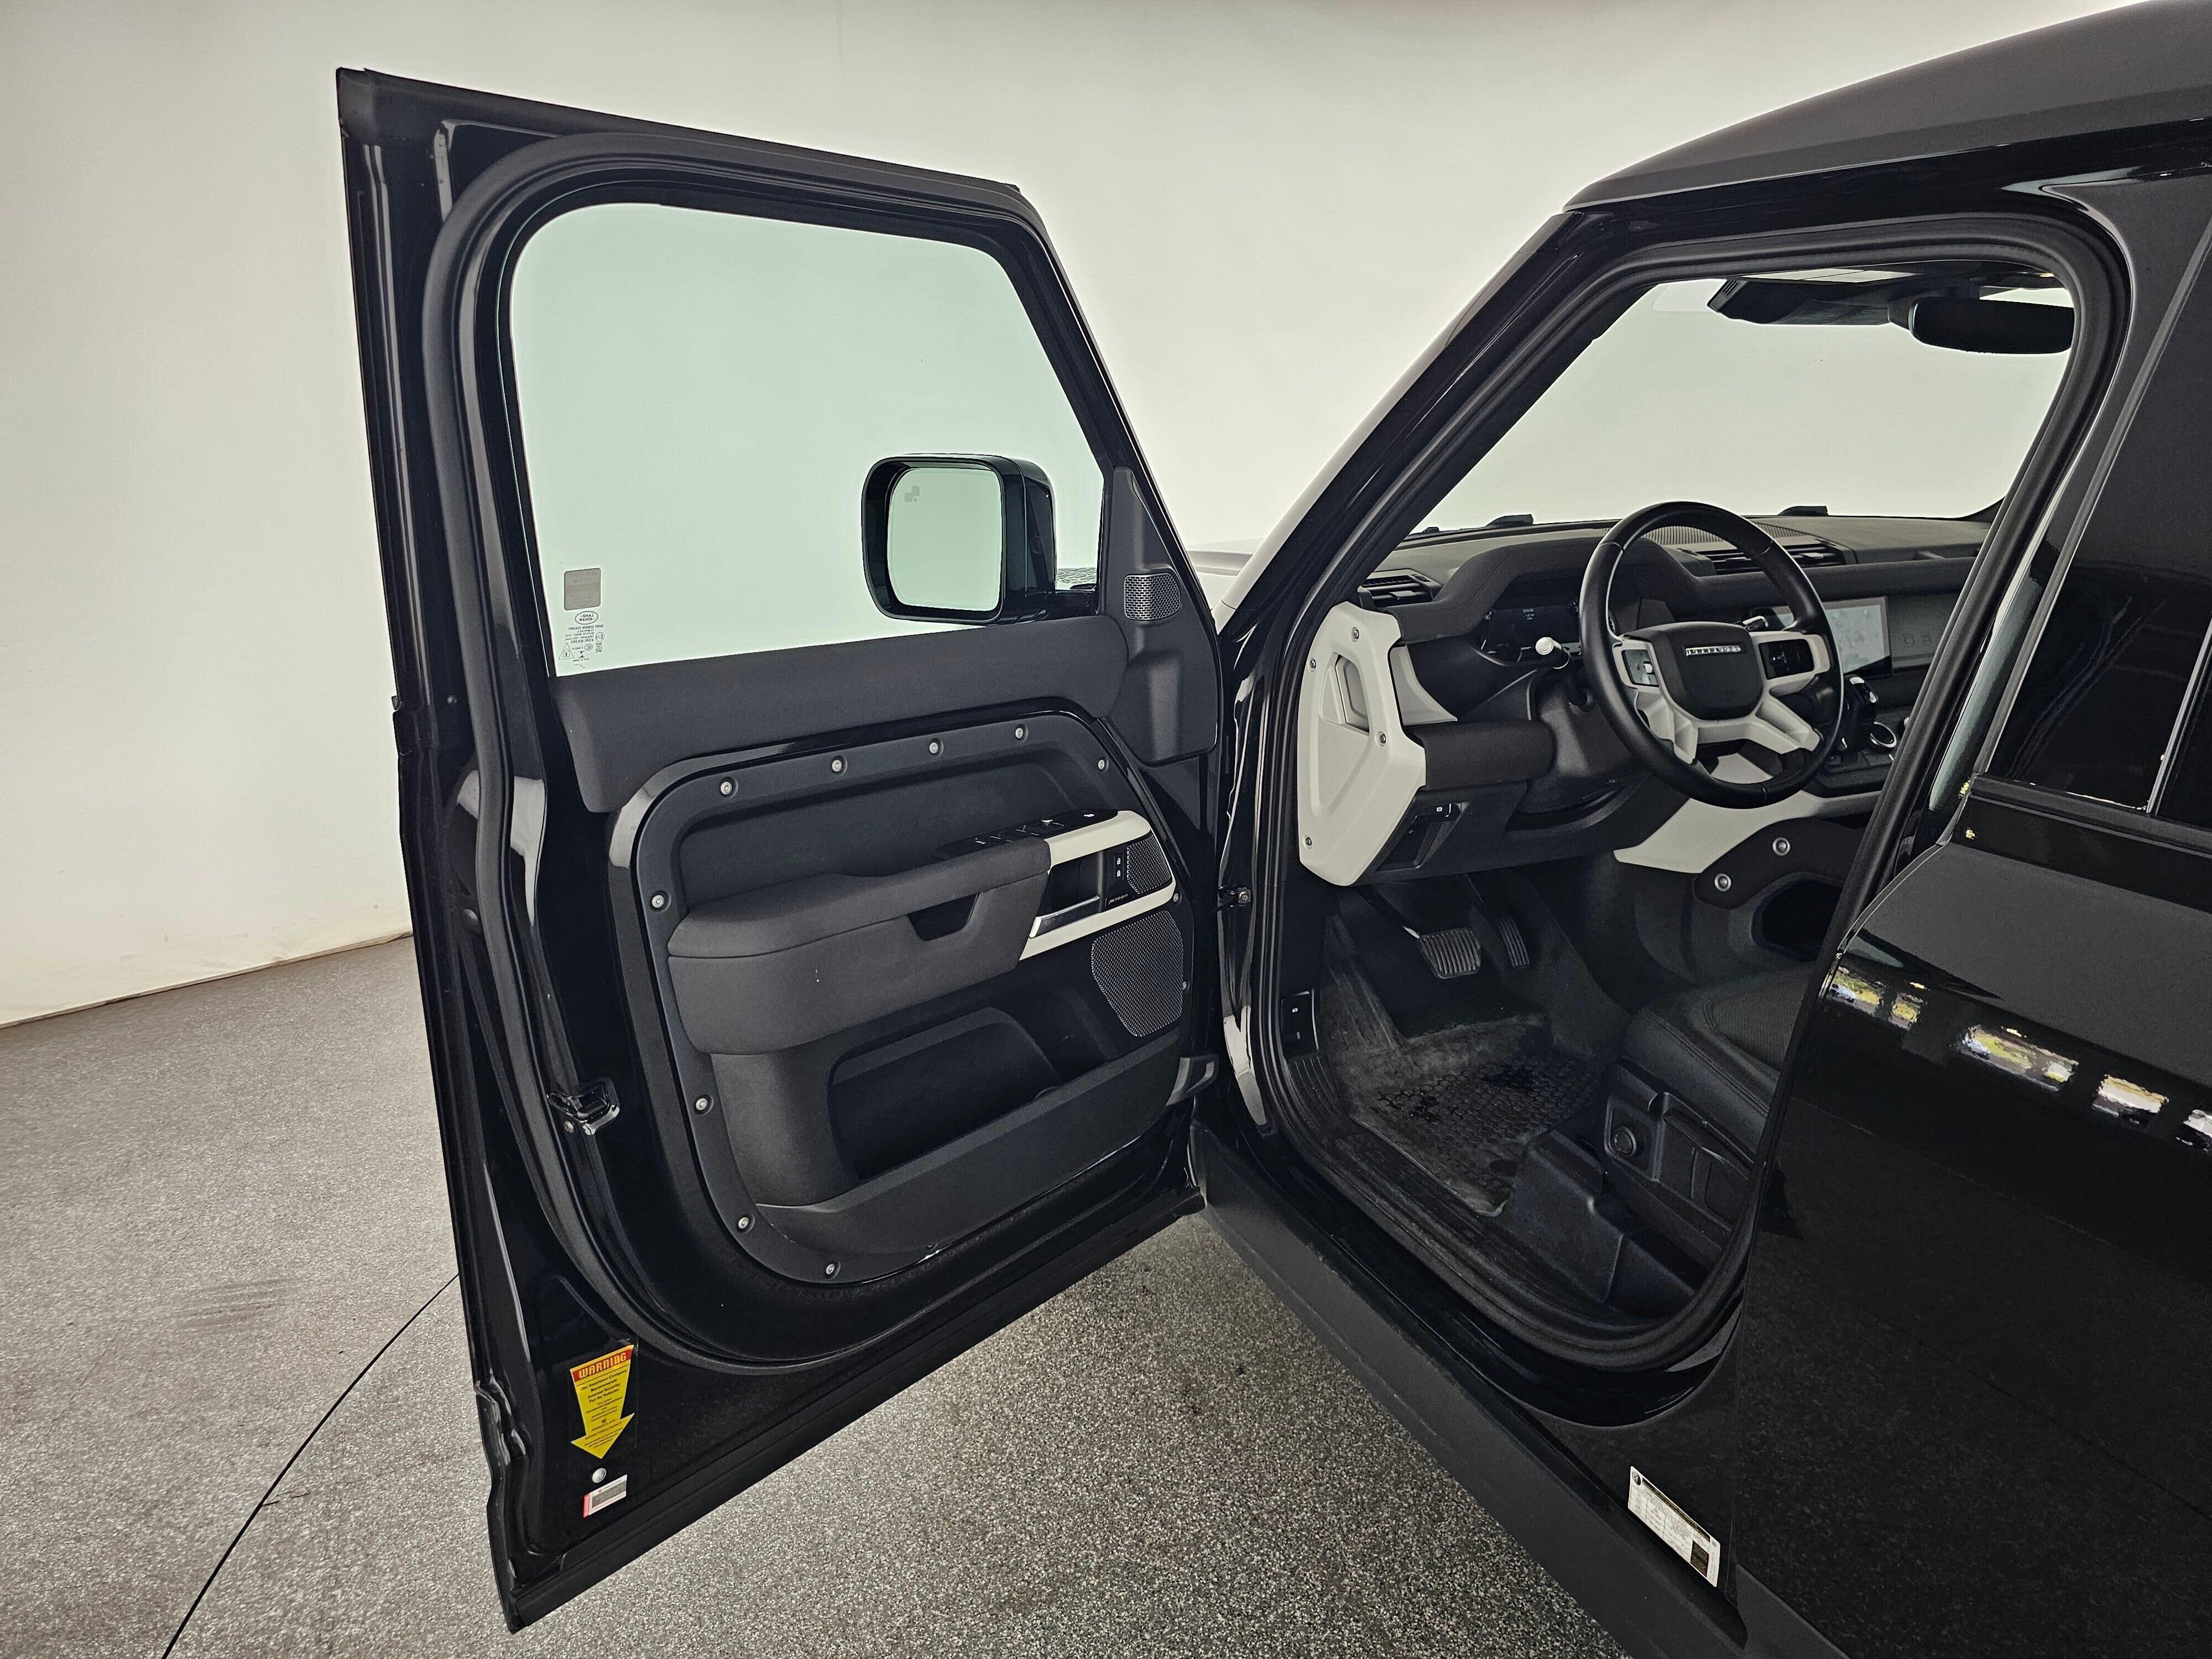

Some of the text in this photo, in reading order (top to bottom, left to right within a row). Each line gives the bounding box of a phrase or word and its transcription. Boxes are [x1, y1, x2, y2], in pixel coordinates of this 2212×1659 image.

[579, 1352, 627, 1379] WARNING
[589, 1377, 608, 1387] Insurance
[609, 1369, 628, 1379] Company
[603, 1388, 619, 1397] Vehicles
[604, 1383, 620, 1392] Security
